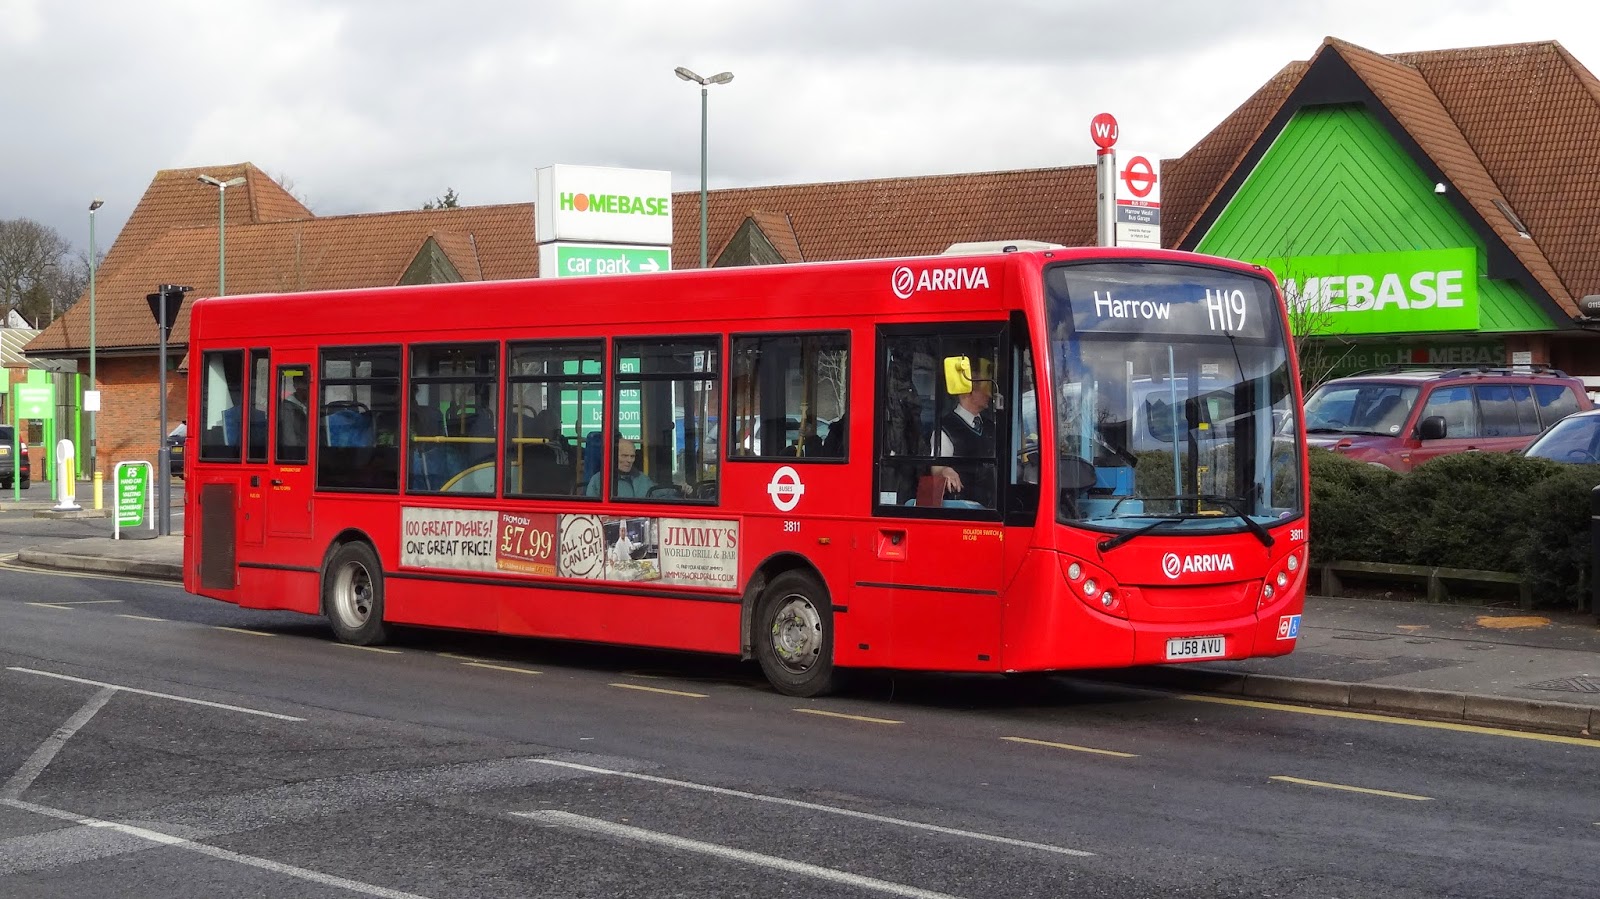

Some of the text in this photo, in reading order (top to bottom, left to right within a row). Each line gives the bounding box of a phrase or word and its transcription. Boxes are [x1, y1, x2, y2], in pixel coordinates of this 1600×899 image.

[1095, 122, 1118, 139] WJ
[560, 191, 669, 217] HOMEBASE
[567, 253, 631, 275] car park
[916, 266, 990, 292] ARRIVA
[1283, 269, 1464, 314] MEBASE
[1093, 288, 1247, 331] Harrow H19
[1300, 349, 1367, 370] elcome
[1397, 345, 1505, 365] HOMEBAS
[406, 519, 493, 538] 100 GREAT DISHES!
[502, 514, 531, 526] FROM ONLY
[783, 521, 800, 532] 3811
[561, 526, 600, 555] ALL YOU
[664, 526, 737, 549] JIMMY'S
[962, 528, 983, 536] ISOLATOR
[1290, 529, 1304, 541] 3811
[406, 539, 493, 556] ONE GREAT PRICE!
[563, 537, 602, 569] CAN EAT!
[664, 547, 736, 560] WORLD GRILL & BAR
[1182, 553, 1234, 573] ARRIVA
[1170, 639, 1221, 656] LJ58 AVU
